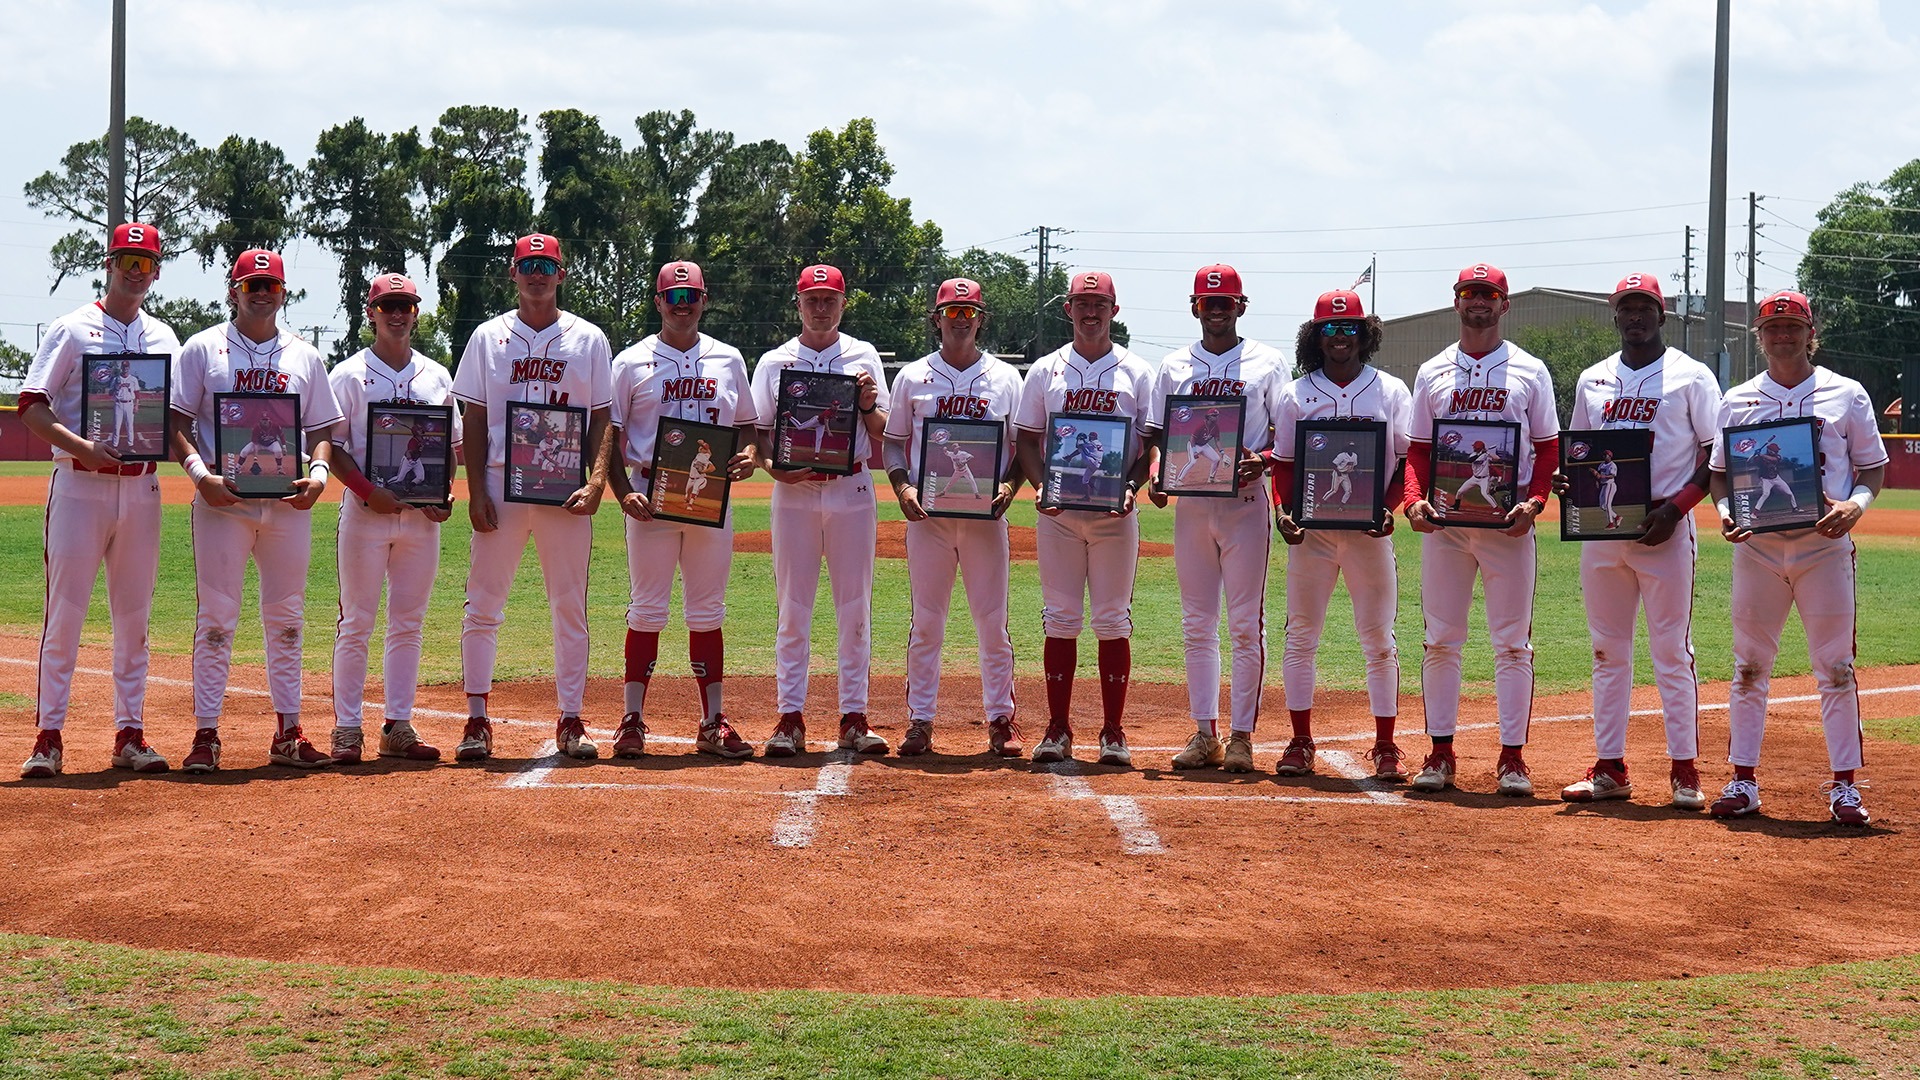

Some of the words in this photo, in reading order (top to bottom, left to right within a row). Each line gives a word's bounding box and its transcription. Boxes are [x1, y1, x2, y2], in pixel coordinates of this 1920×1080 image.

[128, 227, 144, 242] S
[530, 236, 545, 251] S
[254, 253, 270, 269] S
[1473, 265, 1488, 279] S
[389, 275, 403, 290] S
[674, 266, 689, 282] S
[813, 268, 828, 282] S
[1083, 275, 1099, 290] S
[1207, 272, 1222, 289] S
[1626, 274, 1642, 289] S
[955, 281, 969, 296] S
[1331, 296, 1347, 313] S
[233, 368, 291, 393] MOCS
[510, 357, 567, 384] MOCS
[661, 377, 718, 403] MOCS
[1191, 378, 1246, 396] MOCS
[936, 395, 991, 420] MOCS
[1063, 388, 1120, 414] MOCS
[1449, 387, 1510, 413] MOCS
[1602, 397, 1661, 423] MOCS
[782, 435, 793, 463] LEROY
[515, 467, 524, 496] CURRY
[1052, 471, 1062, 502] FISHER
[1168, 463, 1177, 490] RILEY
[655, 470, 668, 513] STEWART
[927, 471, 937, 510] MAGUIRE
[1306, 473, 1315, 519] RELAFORD
[1438, 489, 1448, 519] DUFFY
[1741, 494, 1751, 527] WARDE
[1571, 505, 1580, 533] RILEY
